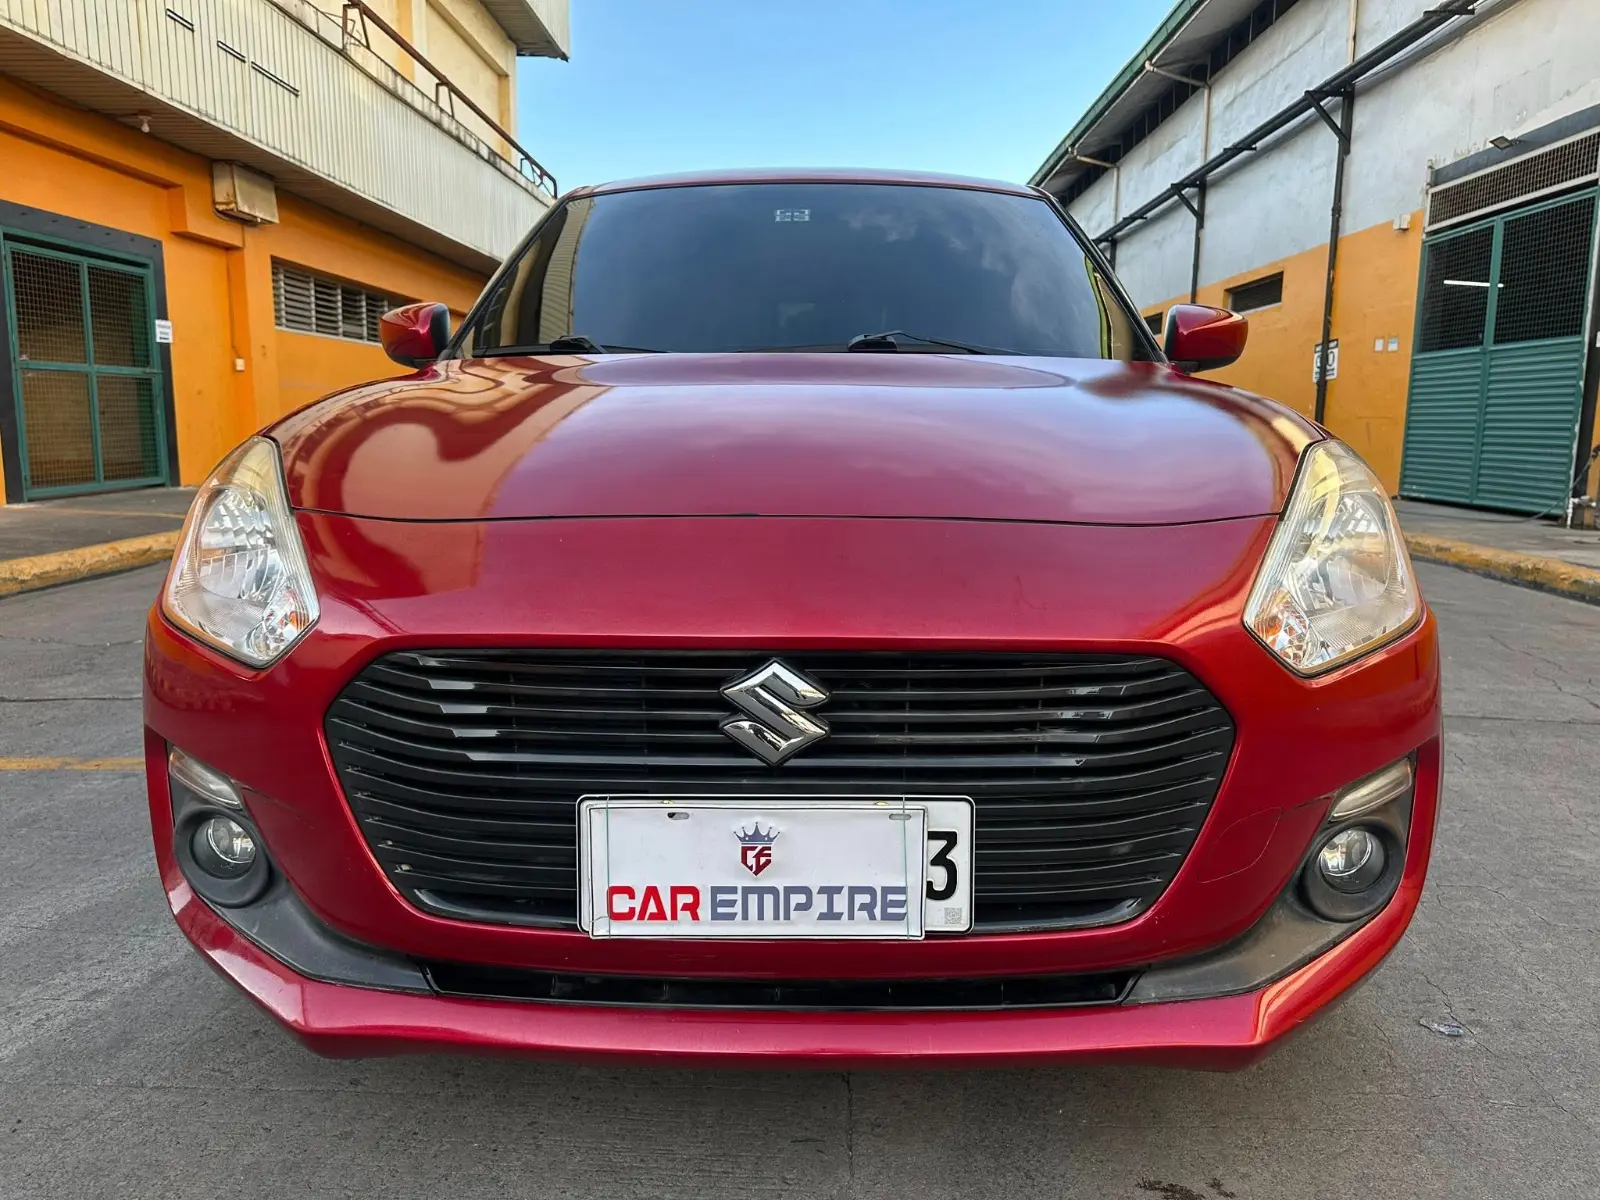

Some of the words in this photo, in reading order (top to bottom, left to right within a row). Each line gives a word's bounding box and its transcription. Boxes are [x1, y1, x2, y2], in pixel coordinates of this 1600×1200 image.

[926, 830, 958, 901] 3
[606, 885, 701, 921] CAR
[710, 885, 908, 921] EMPIRE
